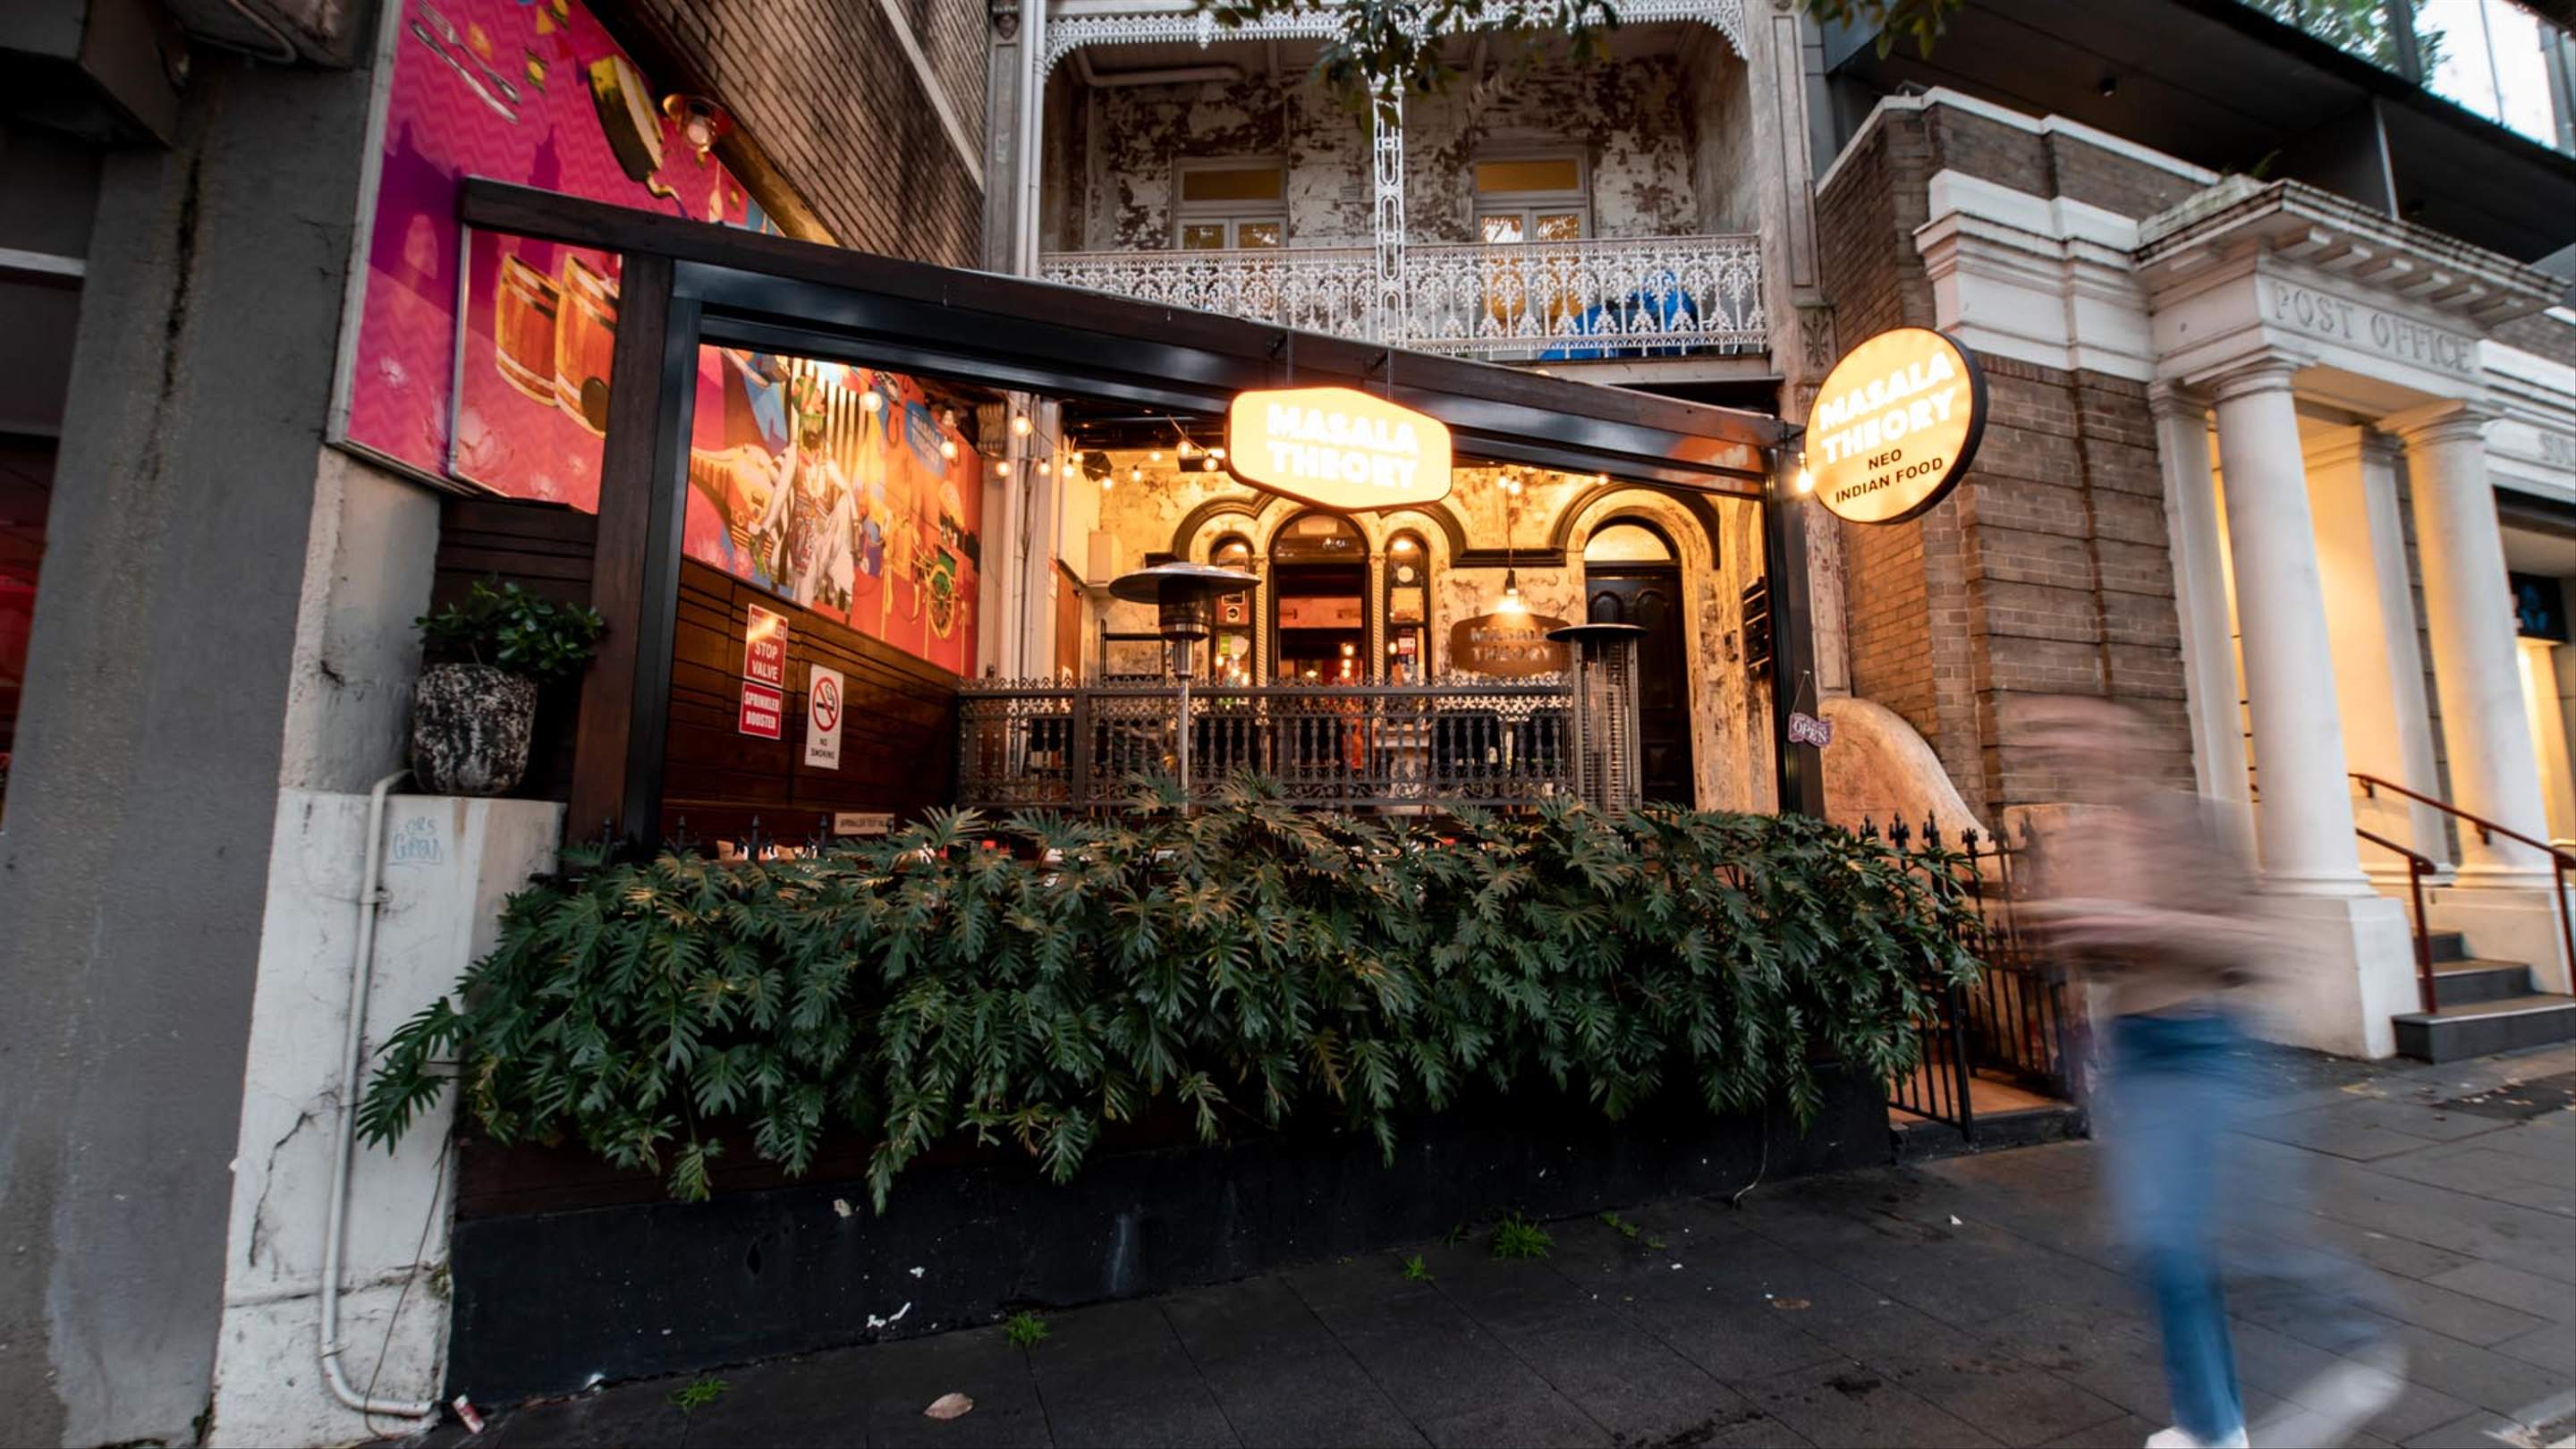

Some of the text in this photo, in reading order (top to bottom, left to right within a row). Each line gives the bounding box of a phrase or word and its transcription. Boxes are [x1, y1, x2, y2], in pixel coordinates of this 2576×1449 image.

[2275, 281, 2473, 375] POST OFFICE
[1818, 352, 1955, 430] MASALA
[1267, 402, 1418, 454] MASALA
[1821, 386, 1955, 464] THEORY
[1266, 440, 1418, 487] THEORY
[1835, 457, 1944, 504] INDIAN FOOD
[1868, 449, 1902, 470] NEO
[751, 660, 779, 681] VALVE
[754, 642, 778, 660] STOP
[1792, 719, 1826, 743] OPEN
